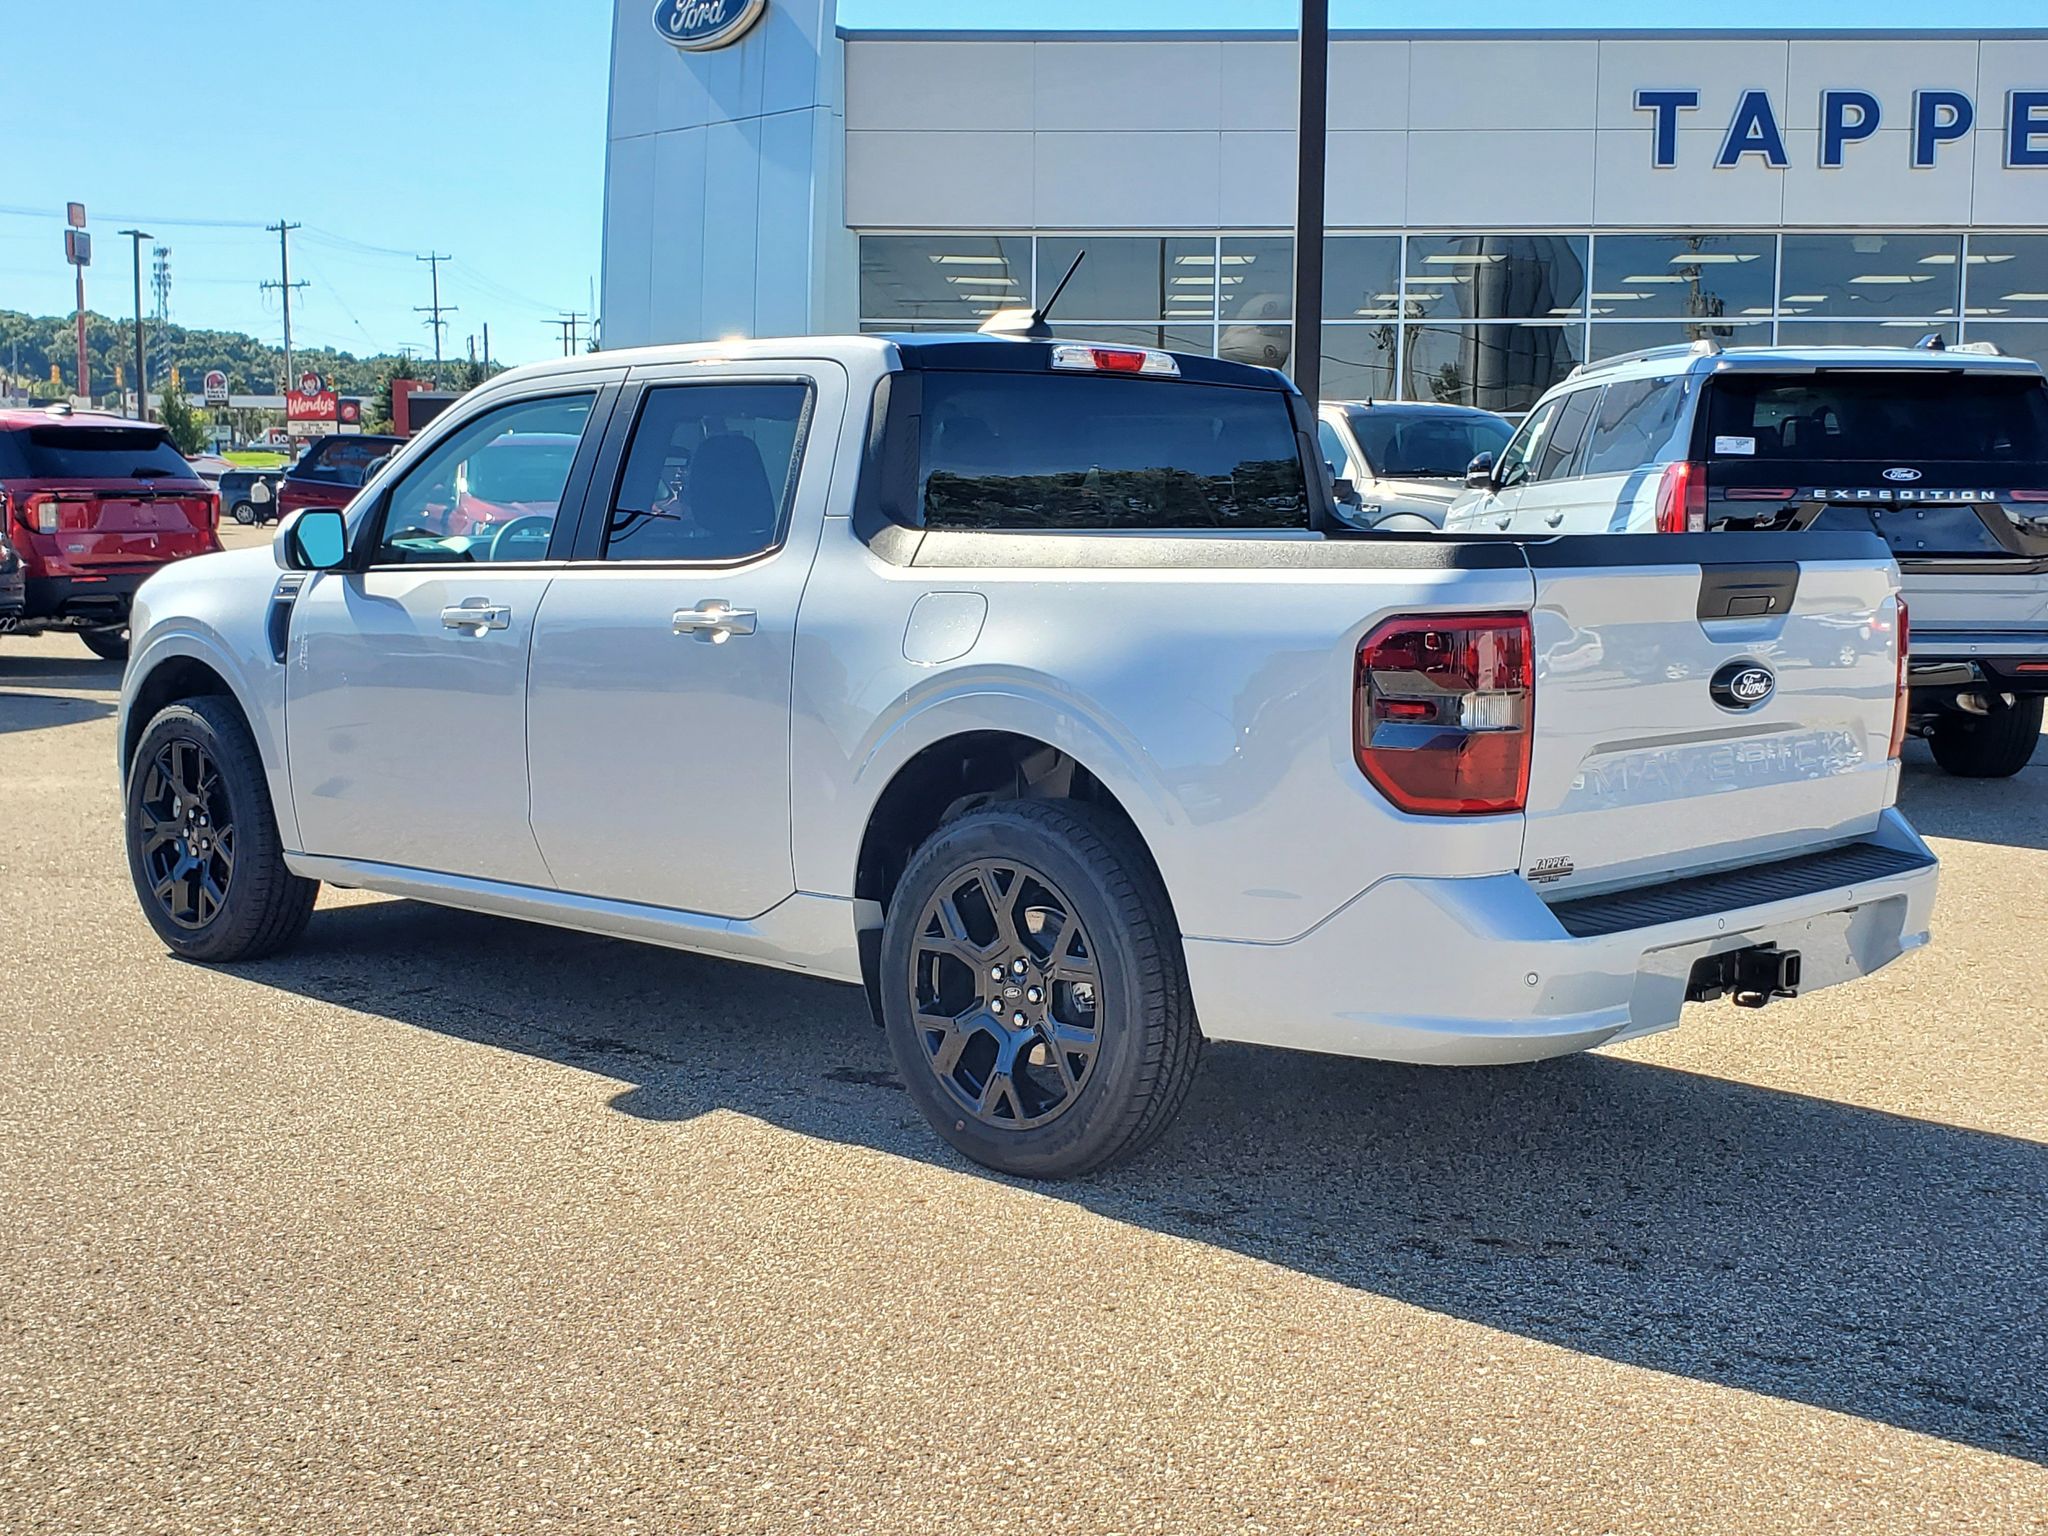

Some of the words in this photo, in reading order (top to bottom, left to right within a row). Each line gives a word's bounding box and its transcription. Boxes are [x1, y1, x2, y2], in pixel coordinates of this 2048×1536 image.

[669, 0, 727, 33] Ford
[1634, 89, 2048, 169] TAPPE
[288, 397, 335, 416] Wendy's
[1813, 489, 1996, 500] EXPEDITION
[1740, 672, 1768, 695] Ford
[1591, 731, 1845, 795] MAVERICK
[1536, 856, 1570, 870] TAPPER
